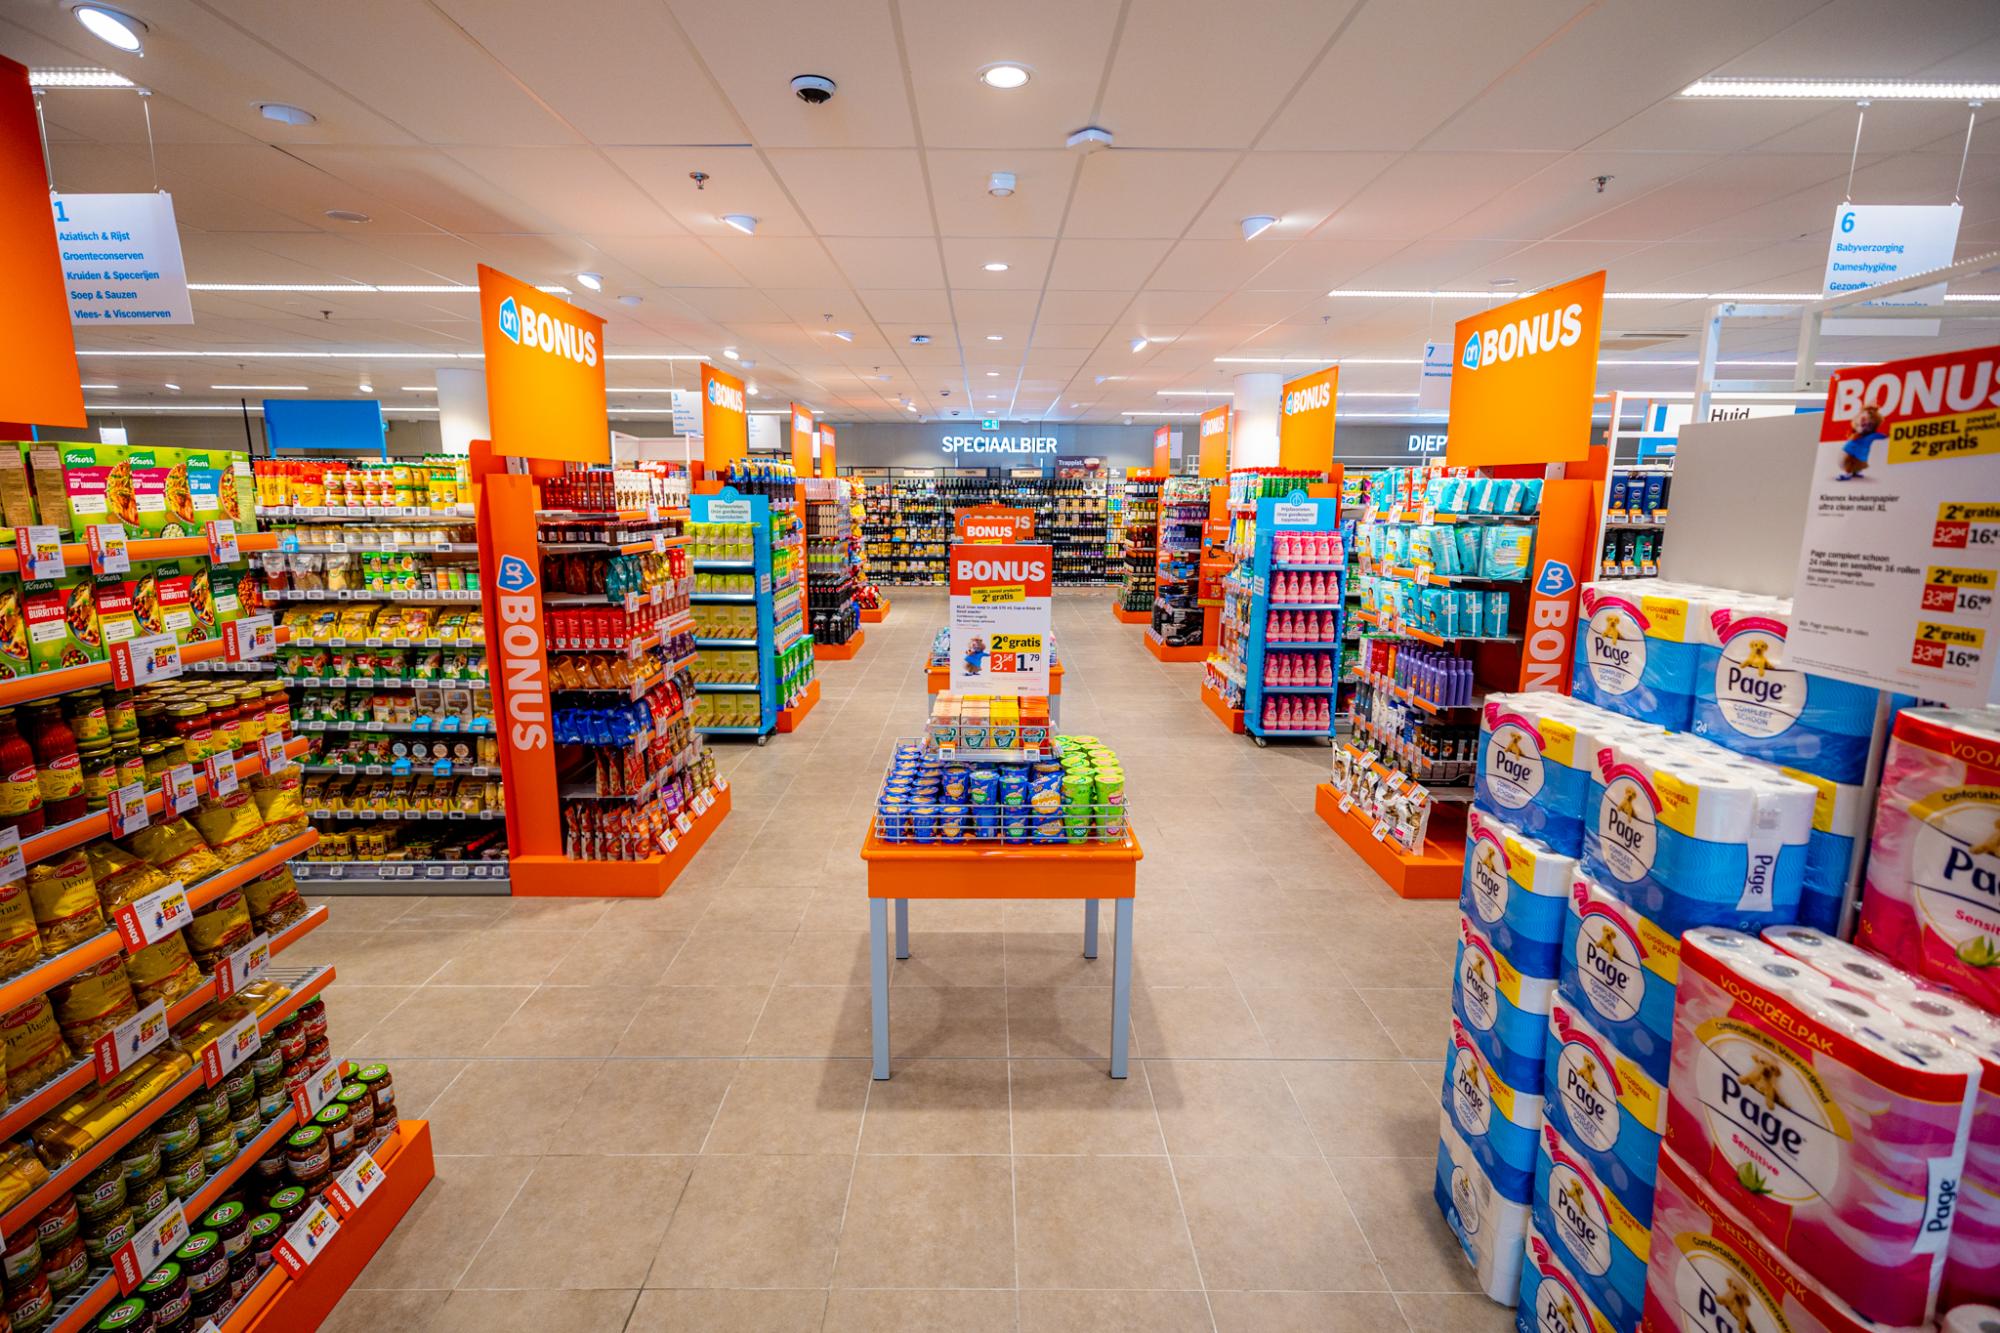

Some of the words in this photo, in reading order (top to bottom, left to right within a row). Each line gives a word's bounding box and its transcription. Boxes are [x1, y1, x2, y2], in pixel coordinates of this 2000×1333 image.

[54, 201, 69, 222] 1
[1841, 212, 1856, 233] 6
[60, 232, 99, 241] Aziatisch
[101, 232, 109, 241] &
[110, 232, 131, 242] Rijst
[63, 252, 145, 261] Groenteconserven
[1836, 243, 1904, 254] Babyverzorging
[67, 271, 102, 280] Kruiden
[103, 271, 111, 280] &
[113, 270, 159, 281] Specerijen
[1833, 262, 1897, 274] Dameshygiëne
[71, 291, 93, 300] Soep
[96, 290, 103, 299] &
[105, 290, 137, 299] Sauzen
[74, 310, 101, 318] Vlees-
[104, 310, 111, 318] &
[113, 309, 171, 318] Visconserven
[520, 305, 598, 367] BONUS
[1481, 303, 1582, 366] BONUS
[1428, 346, 1435, 357] 7
[714, 382, 744, 414] BONUS
[1292, 382, 1330, 413] BONUS
[1894, 420, 1960, 441] DUBBEL
[942, 436, 1058, 454] SPECIAALBIER
[1910, 441, 1927, 455] 2e
[1928, 434, 1978, 456] gratis
[66, 453, 95, 464] Knorr
[129, 456, 155, 465] Knorr
[188, 459, 209, 468] Knorr
[1848, 495, 1900, 503] keukenpapier
[1963, 506, 2000, 519] gratis
[88, 527, 98, 551] BONUS
[208, 522, 217, 544] BONUS
[967, 526, 1013, 537] BONUS
[18, 529, 28, 555] BONUS
[1811, 550, 1826, 558] Page
[1828, 551, 1861, 560] compleet
[1862, 553, 1890, 562] schoon
[157, 568, 179, 576] Knorr
[957, 560, 1046, 582] BONUS
[1819, 559, 1838, 567] rollen
[1851, 562, 1883, 572] sensitive
[1897, 566, 1921, 575] rollen
[24, 580, 53, 591] Knorr
[97, 574, 121, 583] Knorr
[1933, 569, 1952, 584] 2e
[1951, 571, 1989, 585] gratis
[100, 597, 131, 609] BURRITO'S
[992, 593, 1014, 602] gratis
[1957, 594, 1991, 610] 16.99
[28, 606, 65, 619] BURRITO'S
[1646, 606, 1680, 616] VOORDEEL
[992, 635, 1009, 649] 2e
[1008, 637, 1041, 649] gratis
[1941, 627, 1976, 642] gratis
[1595, 637, 1630, 666] Page
[1946, 650, 1980, 667] 16.99
[117, 649, 128, 681] BONUS
[1017, 653, 1040, 672] 1.79
[500, 596, 548, 750] BONUS
[1728, 667, 1783, 703] Page
[1733, 704, 1773, 719] COMPLEET
[1737, 713, 1768, 726] SCHOON
[1696, 720, 1708, 733] 24
[1496, 750, 1531, 781] Page
[1608, 808, 1641, 849] Page
[1476, 862, 1499, 897] Page
[1749, 854, 1773, 895] Page
[123, 913, 140, 944] BONUS
[1586, 943, 1628, 989] Page
[220, 966, 230, 993] BONUS
[1466, 970, 1489, 1006] Page
[1720, 974, 1834, 1055] VOORDEELPAK
[101, 1041, 114, 1074] BONUS
[208, 1050, 219, 1079] BONUS
[1715, 1021, 1761, 1042] Comfortabel
[1763, 1038, 1777, 1048] en
[1779, 1046, 1830, 1104] Verzorgend
[1459, 1069, 1484, 1112] Page
[1619, 1067, 1652, 1102] VOORDEEL
[1567, 1069, 1605, 1121] Page
[1721, 1072, 1802, 1154] Page
[305, 1157, 321, 1169] HAK
[1731, 1133, 1780, 1176] Sensitive
[94, 1185, 117, 1199] HAK
[331, 1189, 351, 1213] BONUS
[1927, 1179, 1956, 1234] Page
[40, 1219, 64, 1233] HAK
[1558, 1188, 1597, 1246] Page
[105, 1228, 127, 1244] HAK
[1692, 1237, 1741, 1268] Comfortabel
[1696, 1194, 1807, 1302] VOORDEELPAK
[69, 1254, 87, 1273] HAK
[120, 1252, 136, 1284] BONUS
[279, 1246, 300, 1271] BONUS
[208, 1260, 226, 1277] HAK
[15, 1300, 41, 1319] HAK
[159, 1302, 181, 1316] HAK
